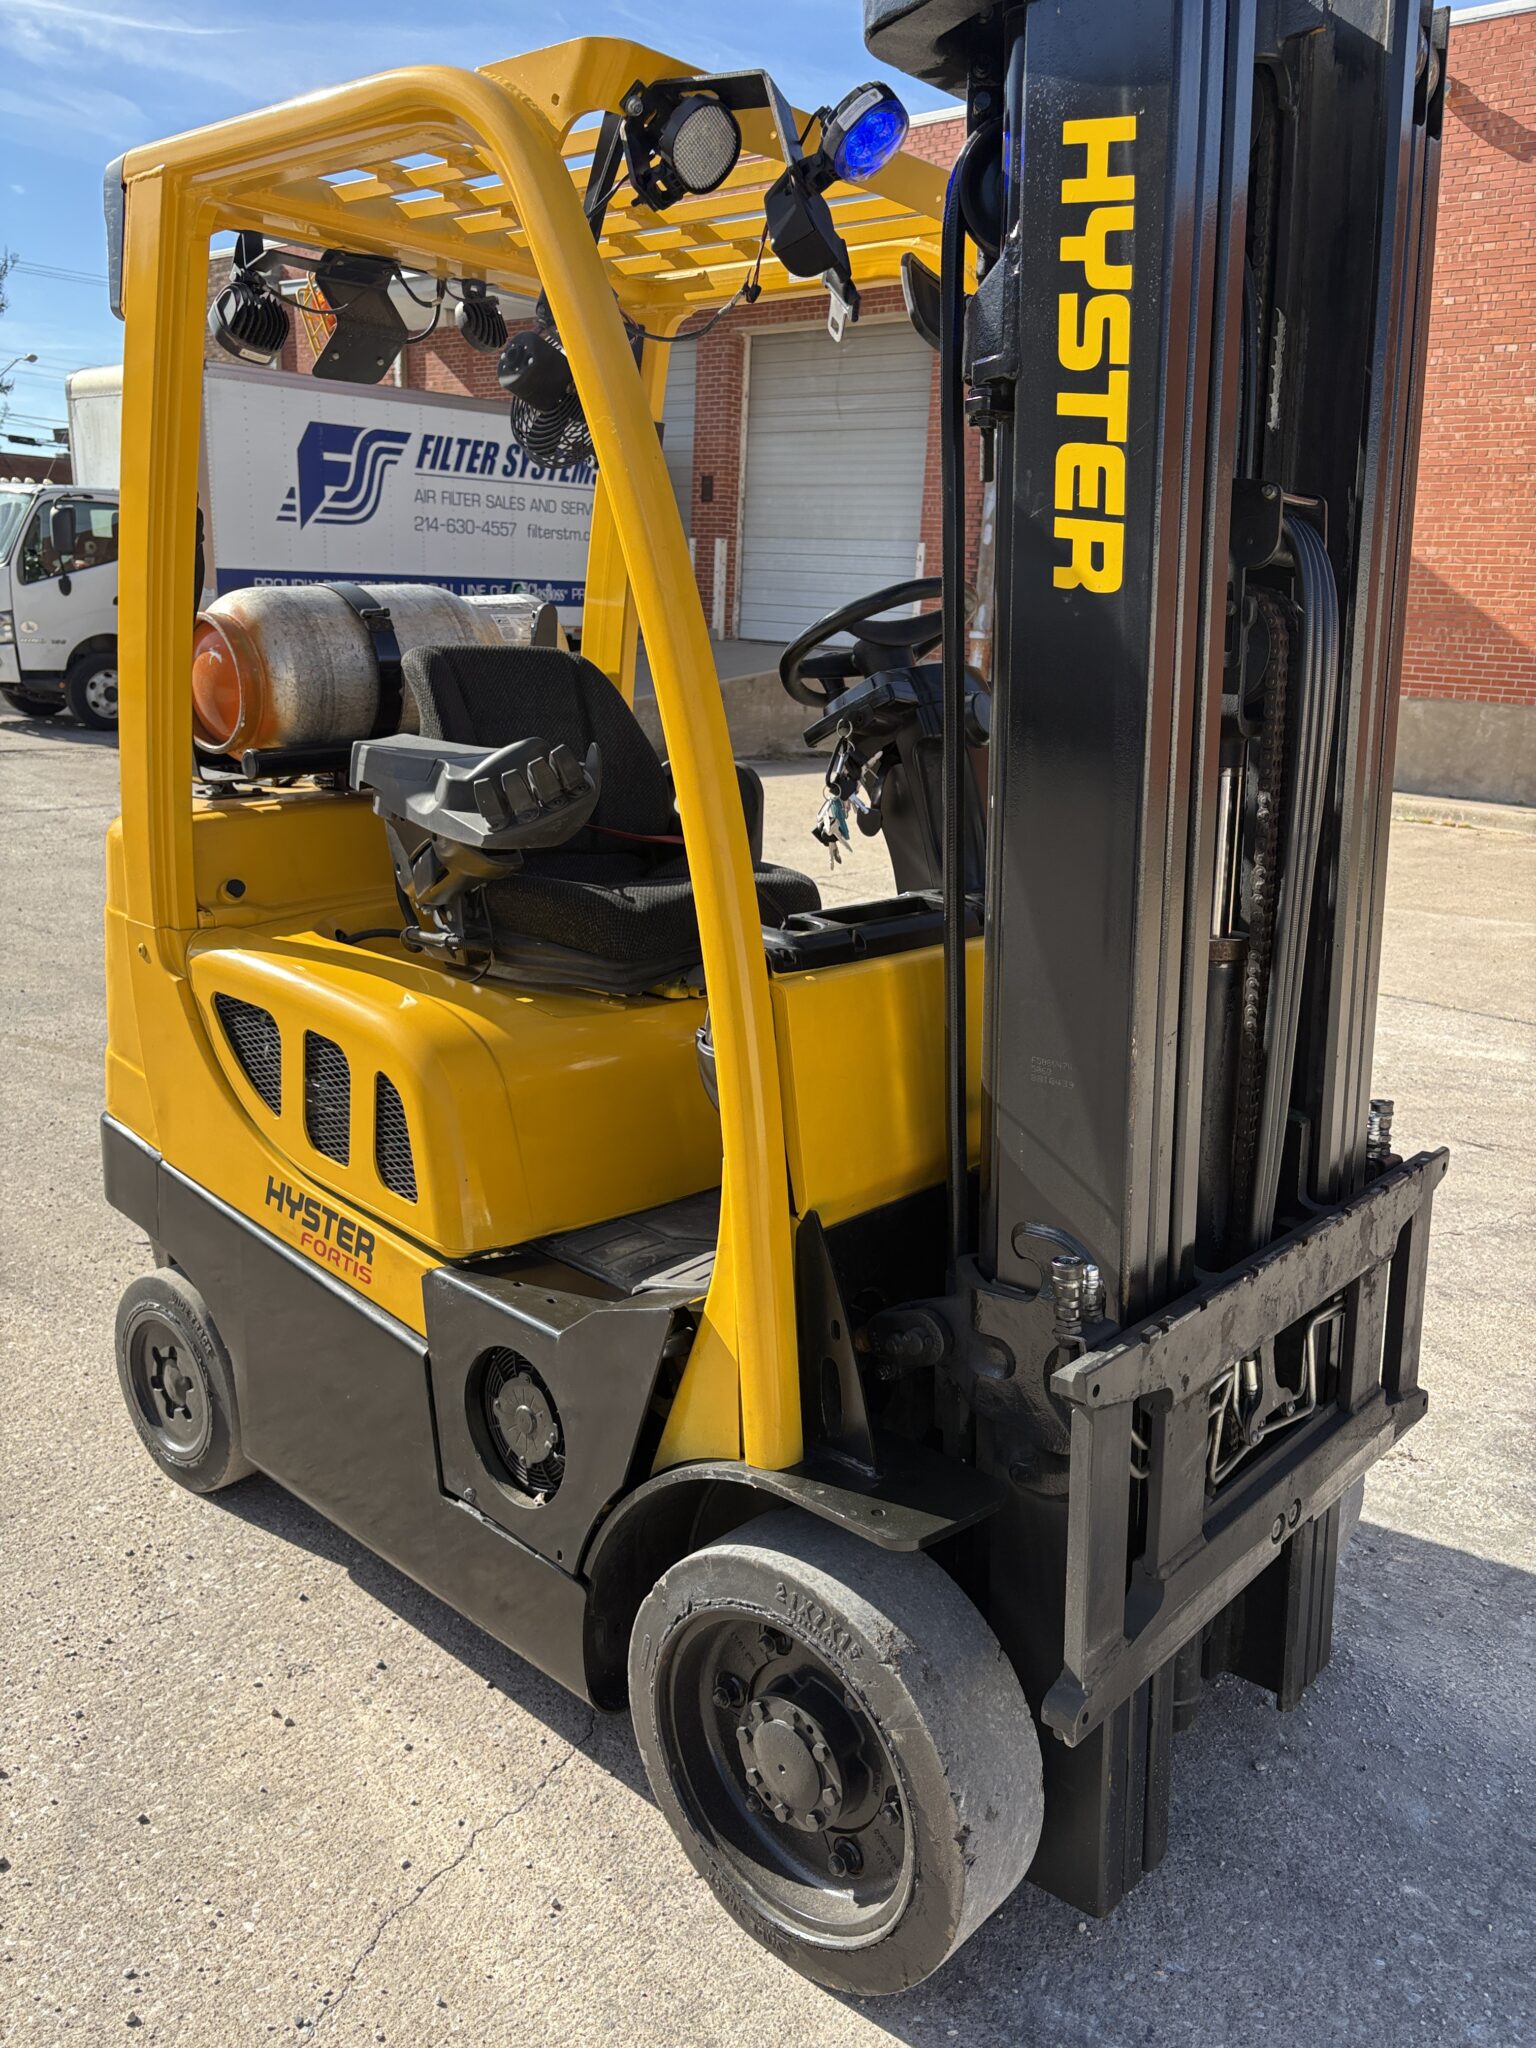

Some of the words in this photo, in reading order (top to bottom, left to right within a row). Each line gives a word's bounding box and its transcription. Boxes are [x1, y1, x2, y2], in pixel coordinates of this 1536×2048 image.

[1053, 115, 1137, 594] HYSTER
[415, 434, 500, 476] FILTER
[414, 488, 436, 504] AIR
[441, 490, 482, 508] FILTER
[485, 493, 526, 512] SALES
[529, 498, 557, 514] AND
[413, 515, 517, 537] 214-630-4557
[460, 583, 487, 596] LINE
[490, 584, 507, 595] OF
[265, 1175, 376, 1266] HYSTER
[300, 1231, 373, 1285] FORTIS
